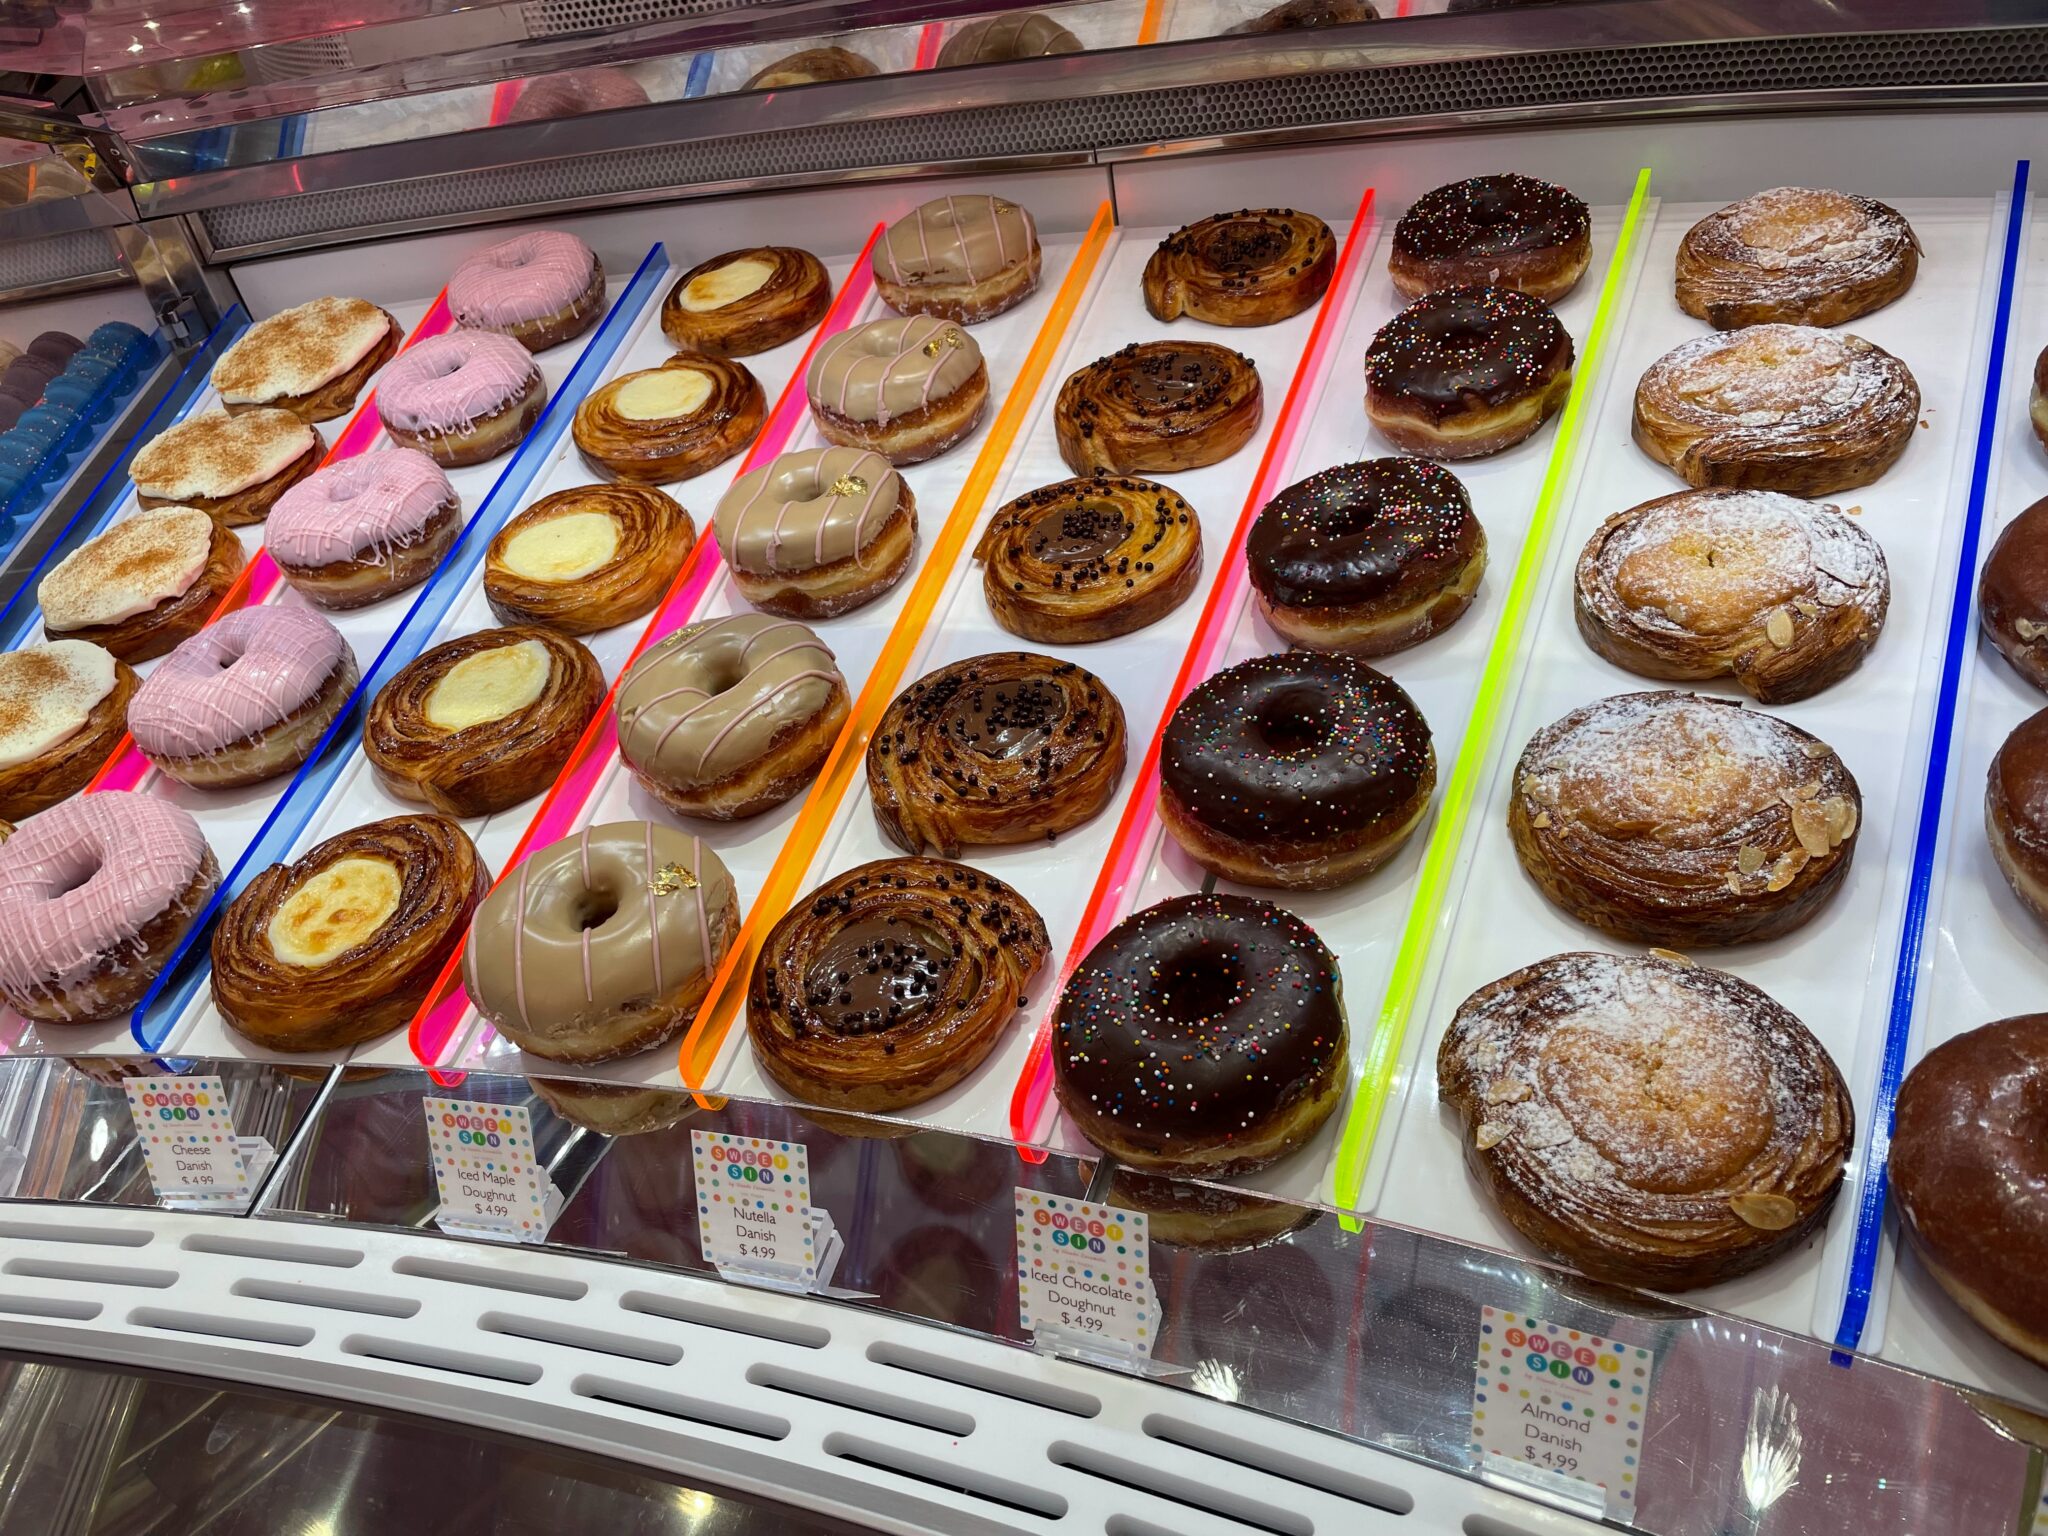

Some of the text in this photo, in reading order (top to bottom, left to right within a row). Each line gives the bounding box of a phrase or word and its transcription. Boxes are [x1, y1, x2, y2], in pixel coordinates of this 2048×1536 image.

[145, 1094, 207, 1106] SWEET
[162, 1108, 198, 1119] SIN
[444, 1115, 510, 1132] SWEET
[461, 1131, 498, 1146] SIN
[172, 1144, 211, 1155] Cheese
[713, 1147, 786, 1168] SWEET
[176, 1160, 212, 1171] Danish
[730, 1165, 772, 1182] SIN
[457, 1169, 516, 1187] Iced Maple
[463, 1185, 516, 1202] Doughnut
[474, 1203, 508, 1217] $ 4.99
[733, 1207, 776, 1224] Nutella
[736, 1225, 776, 1242] Danish
[1036, 1211, 1120, 1239] SWEET
[1055, 1232, 1103, 1252] SIN
[739, 1243, 776, 1259] $ 4.99
[1031, 1268, 1133, 1301] Iced Chocolate
[1048, 1290, 1116, 1317] Doughnut
[1061, 1311, 1103, 1331] $ 4.99
[1508, 1330, 1616, 1371] SWEET
[1529, 1355, 1591, 1383] SIN
[1521, 1402, 1591, 1434] Almond
[1525, 1424, 1582, 1452] Danish
[1525, 1445, 1578, 1471] $ 4.99
